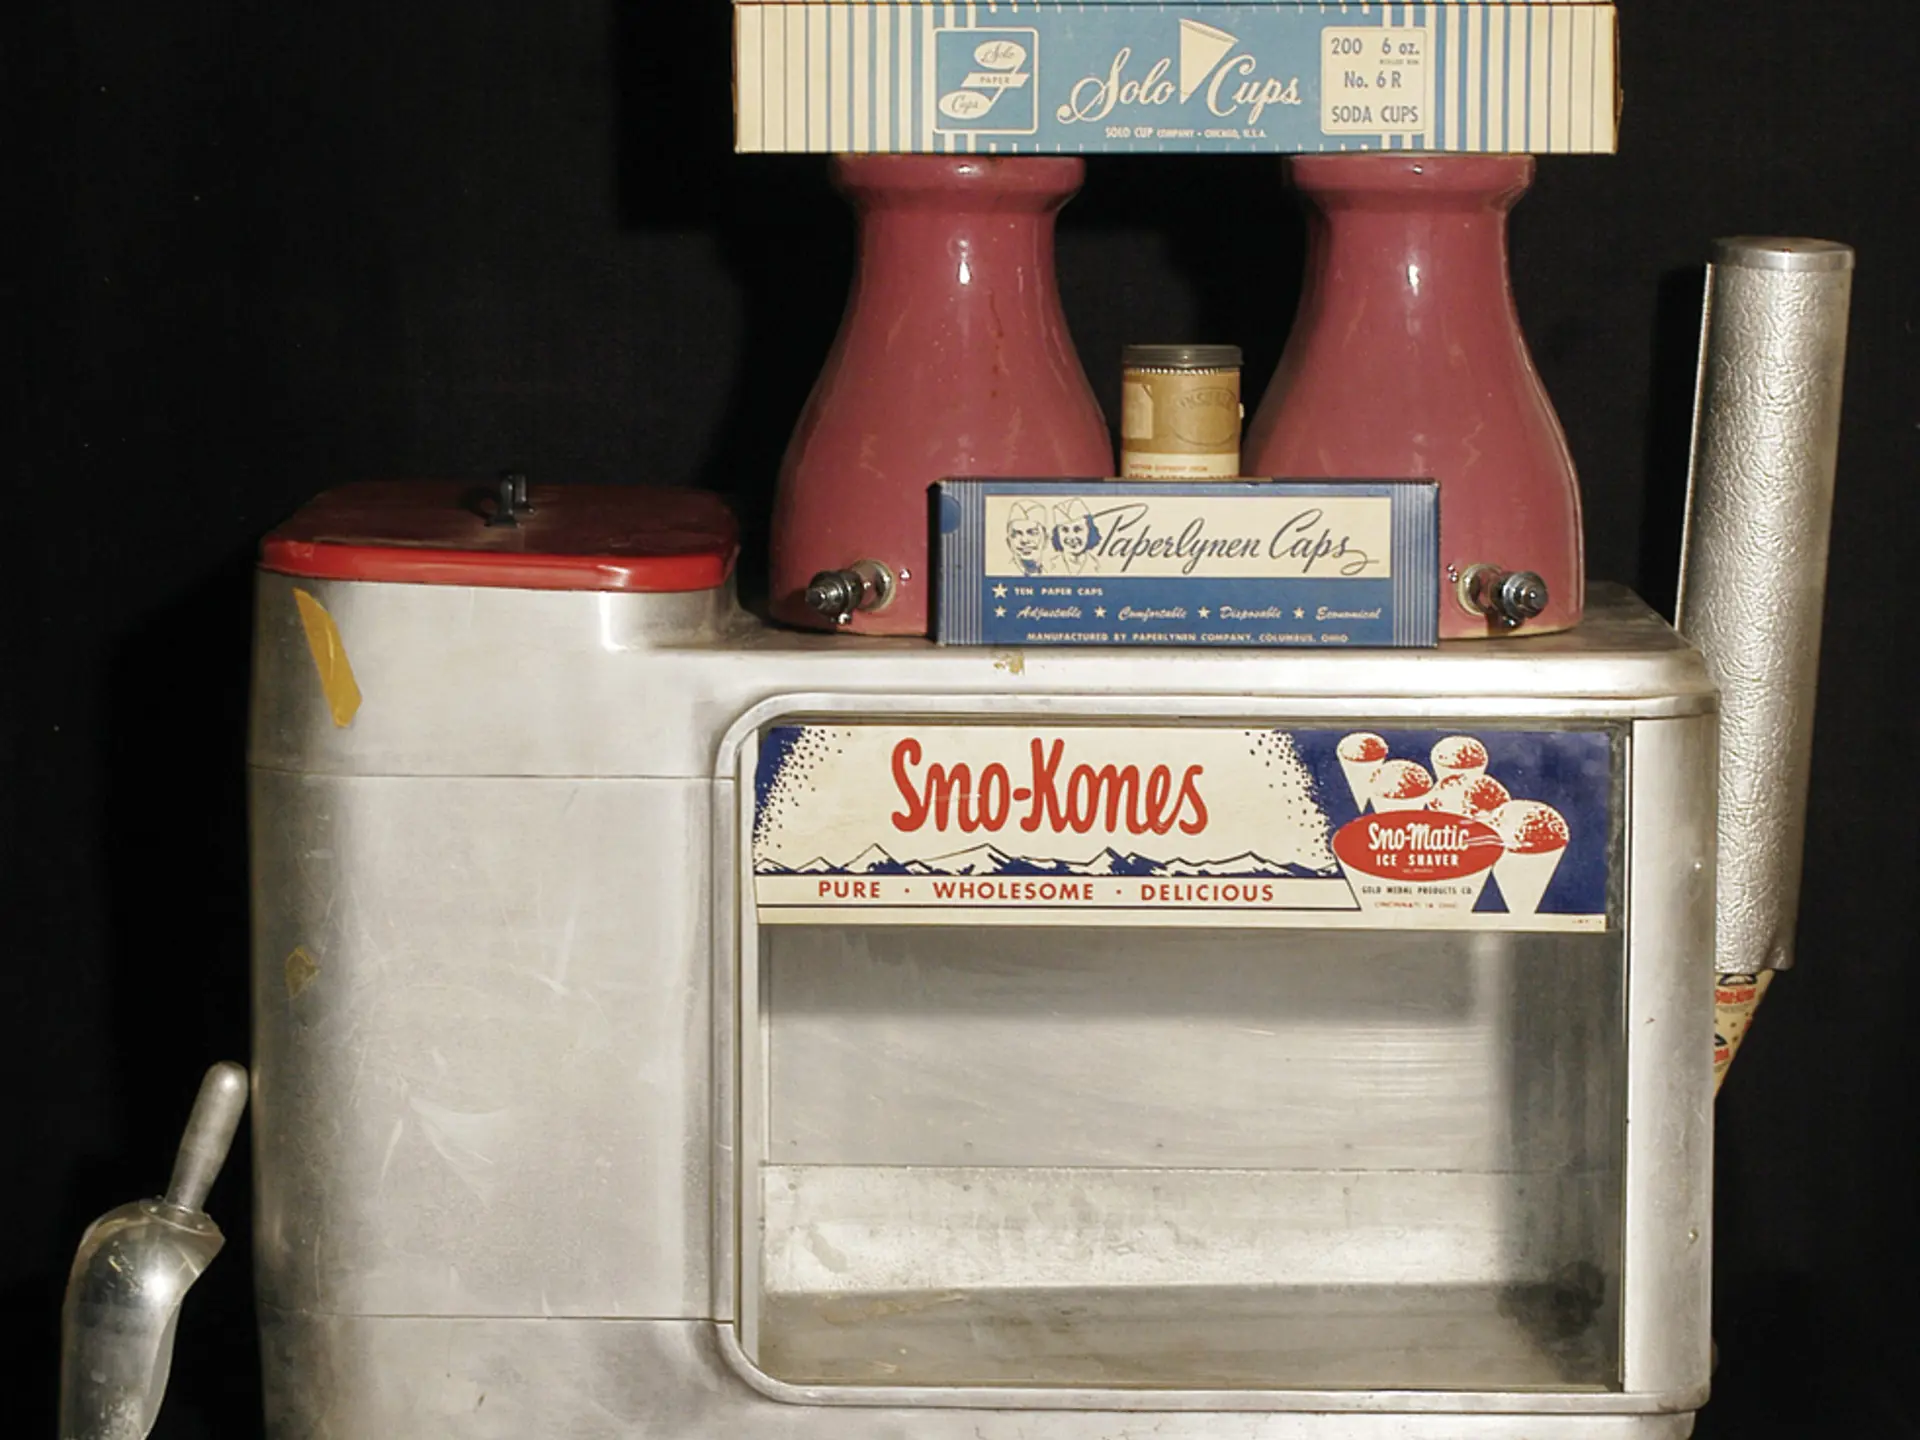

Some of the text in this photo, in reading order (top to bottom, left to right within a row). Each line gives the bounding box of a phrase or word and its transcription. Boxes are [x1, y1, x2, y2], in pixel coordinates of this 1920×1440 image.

[1331, 37, 1420, 55] 200 6 oz.
[980, 76, 1010, 84] PAPER
[1056, 47, 1301, 125] Solo Cups
[1344, 70, 1402, 88] No. 6 R
[951, 94, 979, 114] Cups
[1331, 105, 1419, 123] SODA CUPS
[1105, 126, 1131, 138] SOLO
[1134, 126, 1154, 138] CUP
[1090, 503, 1380, 576] Paperlynen Caps
[1014, 587, 1103, 596] TEN PAPER CAPS
[1016, 605, 1382, 623] Adjustable Comfortable Disposable Economical
[1027, 632, 1108, 641] MANUFACTURED
[1113, 632, 1127, 641] BY
[1132, 633, 1196, 642] PAPERLYNEN
[1321, 634, 1349, 643] OHIO
[891, 737, 1208, 834] Sno-Kones
[1368, 822, 1469, 851] Sno-Matic
[1376, 854, 1460, 867] ICE SHAVER
[818, 880, 1275, 903] PURE WHOLESOME DELICIOUS
[1361, 886, 1381, 895] GOLD
[1386, 886, 1413, 895] MEDAL
[1417, 886, 1457, 895] PRODUCTS
